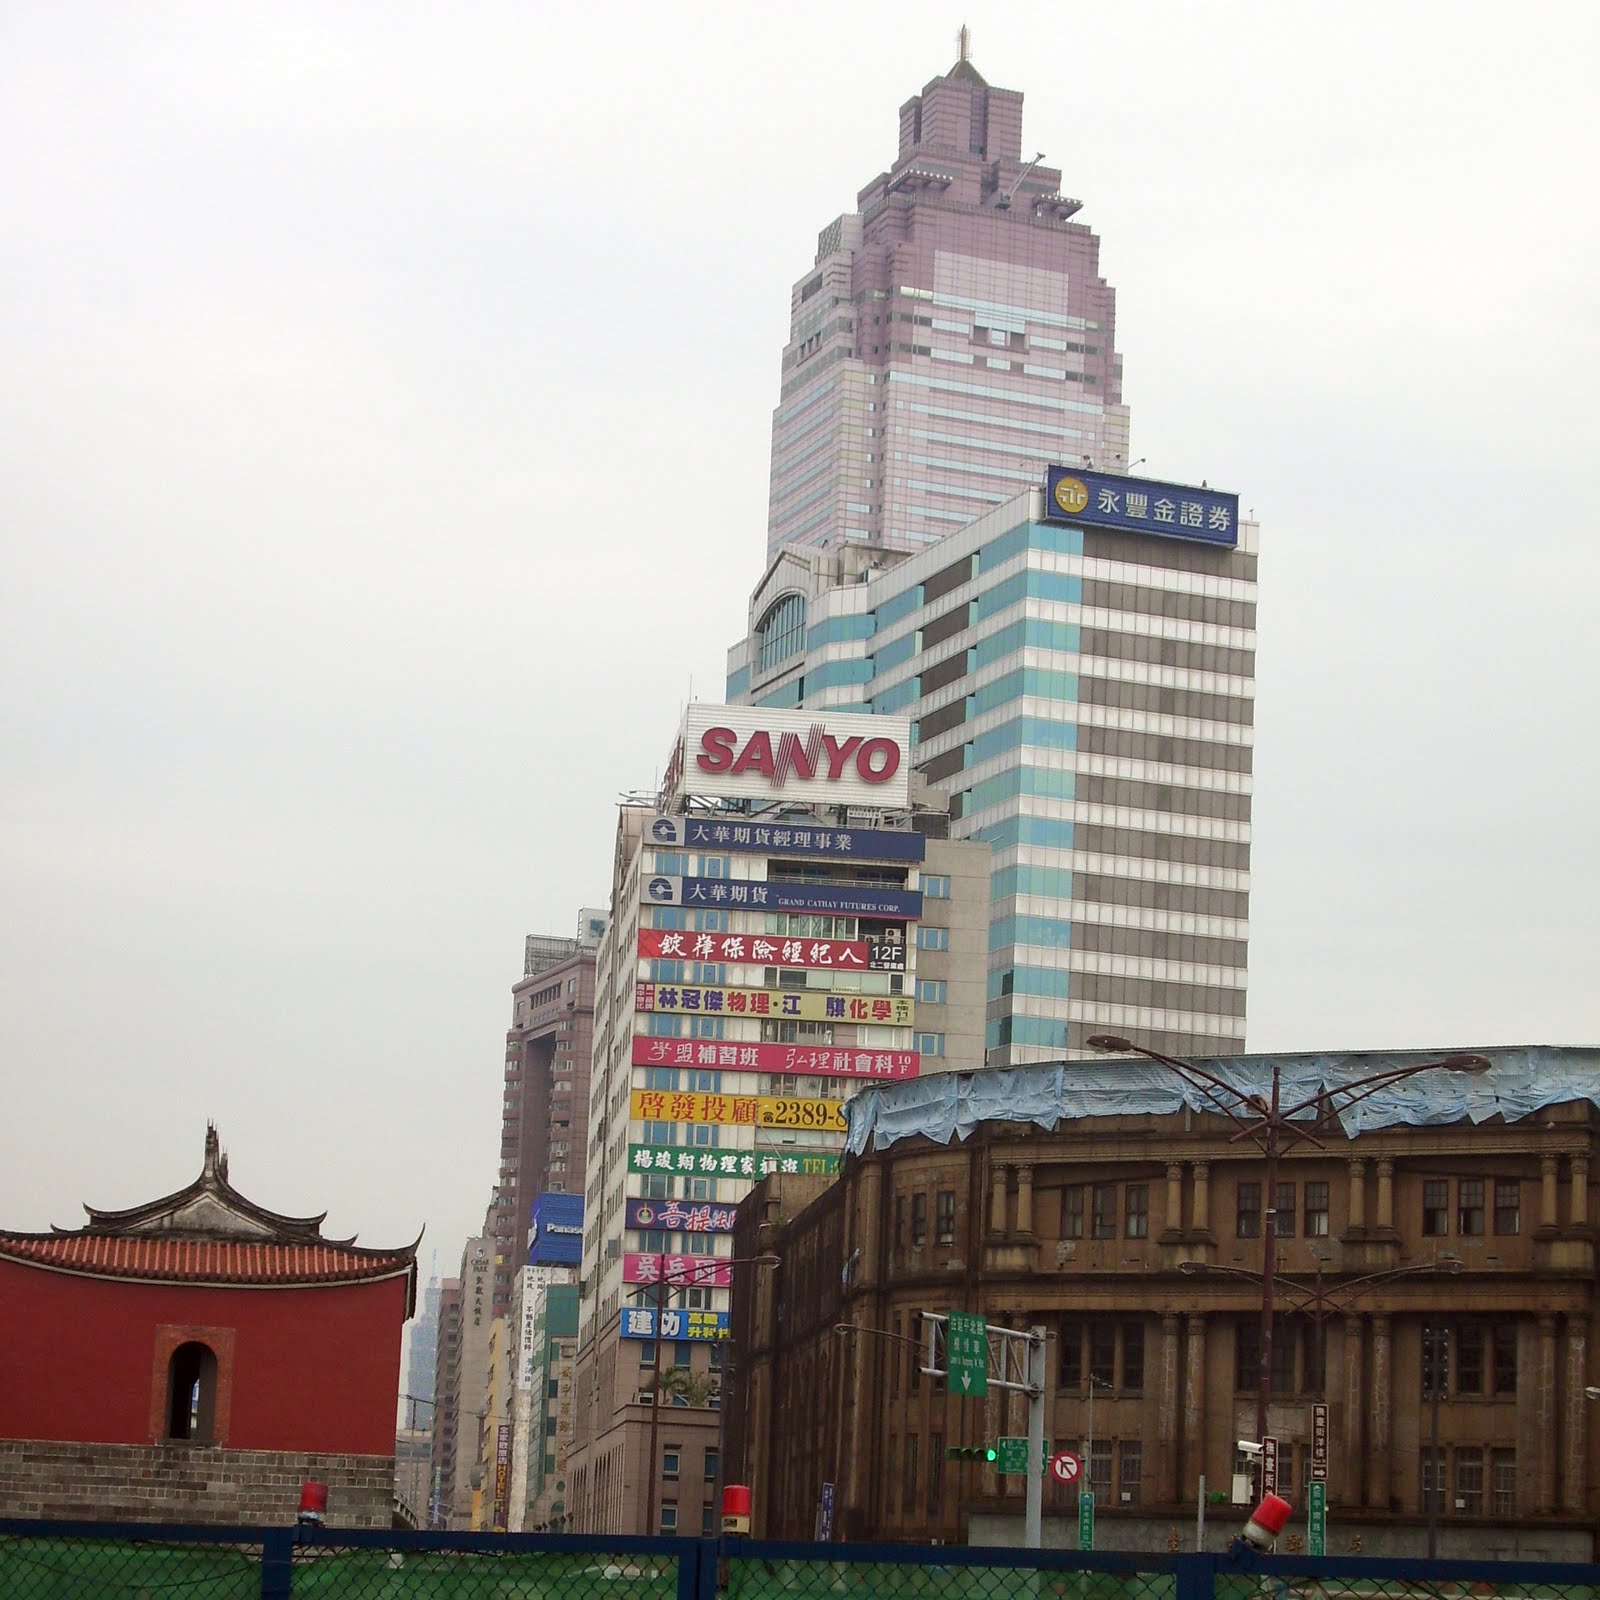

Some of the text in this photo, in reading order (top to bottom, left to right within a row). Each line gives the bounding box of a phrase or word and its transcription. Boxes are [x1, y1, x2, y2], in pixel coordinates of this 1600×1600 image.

[1097, 487, 1231, 532] 永豐金證券
[696, 722, 901, 788] SANYO
[691, 823, 852, 851] 大華期貨經理事業
[688, 883, 769, 905] 大華期貨
[778, 898, 900, 912] GRAND CATHAY FUTURES CORP.
[872, 946, 903, 960] 12F
